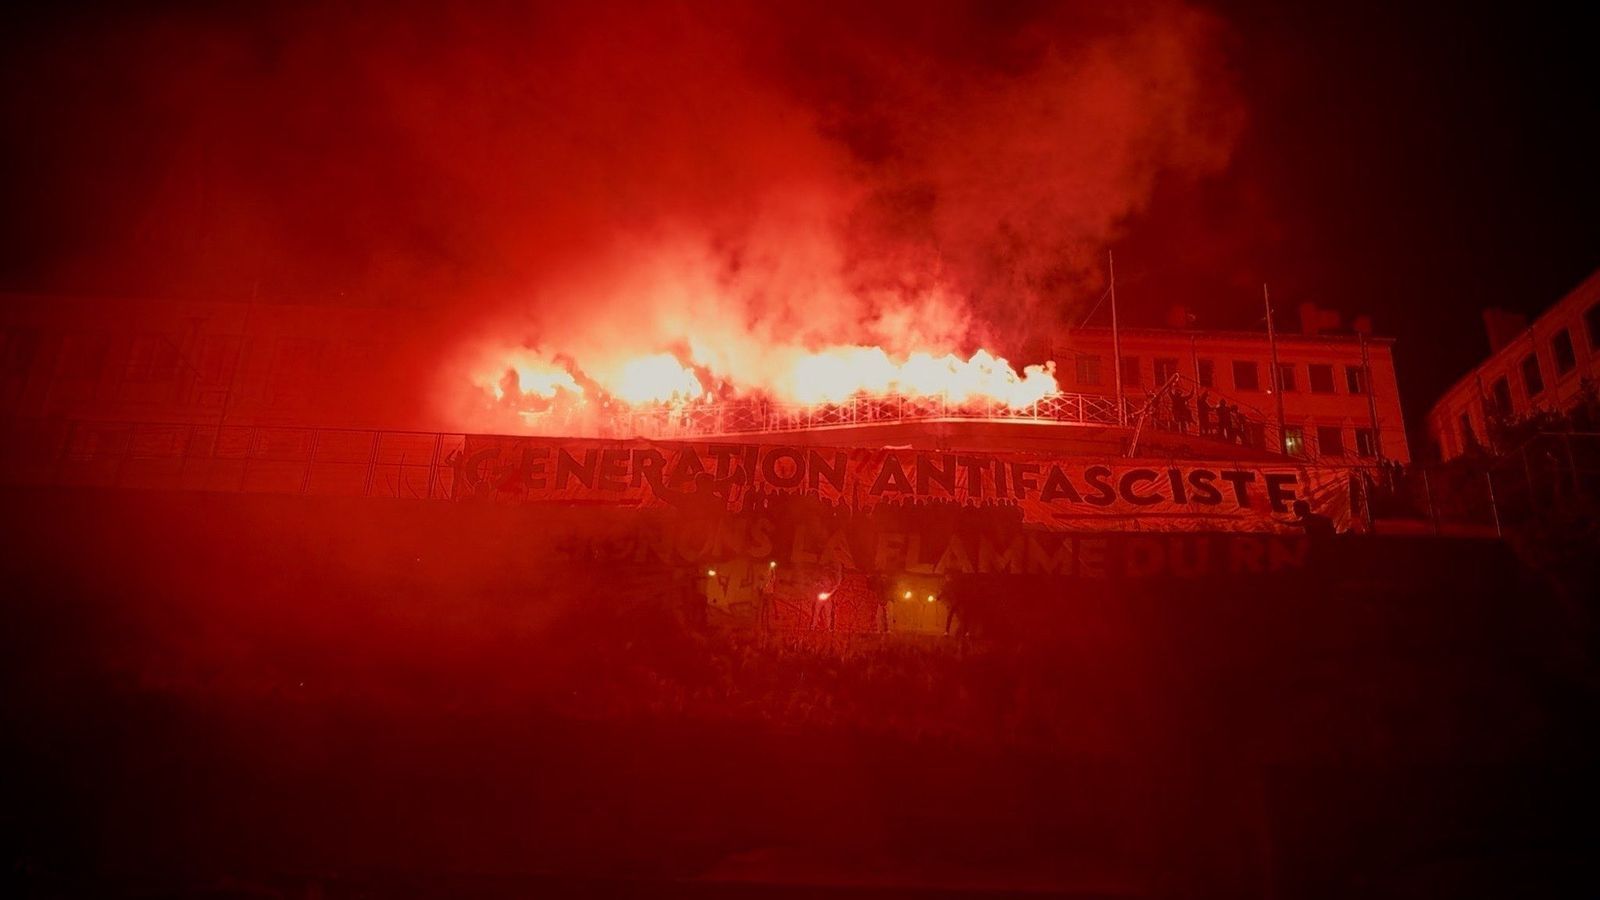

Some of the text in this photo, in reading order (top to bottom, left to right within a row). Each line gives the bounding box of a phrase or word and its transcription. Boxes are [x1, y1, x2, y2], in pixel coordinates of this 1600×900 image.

[869, 452, 1298, 513] ANTIFASCISTE
[790, 524, 855, 570] LA
[874, 529, 1107, 579] FLAMME
[1125, 535, 1211, 578] DU
[1229, 535, 1310, 576] RN
